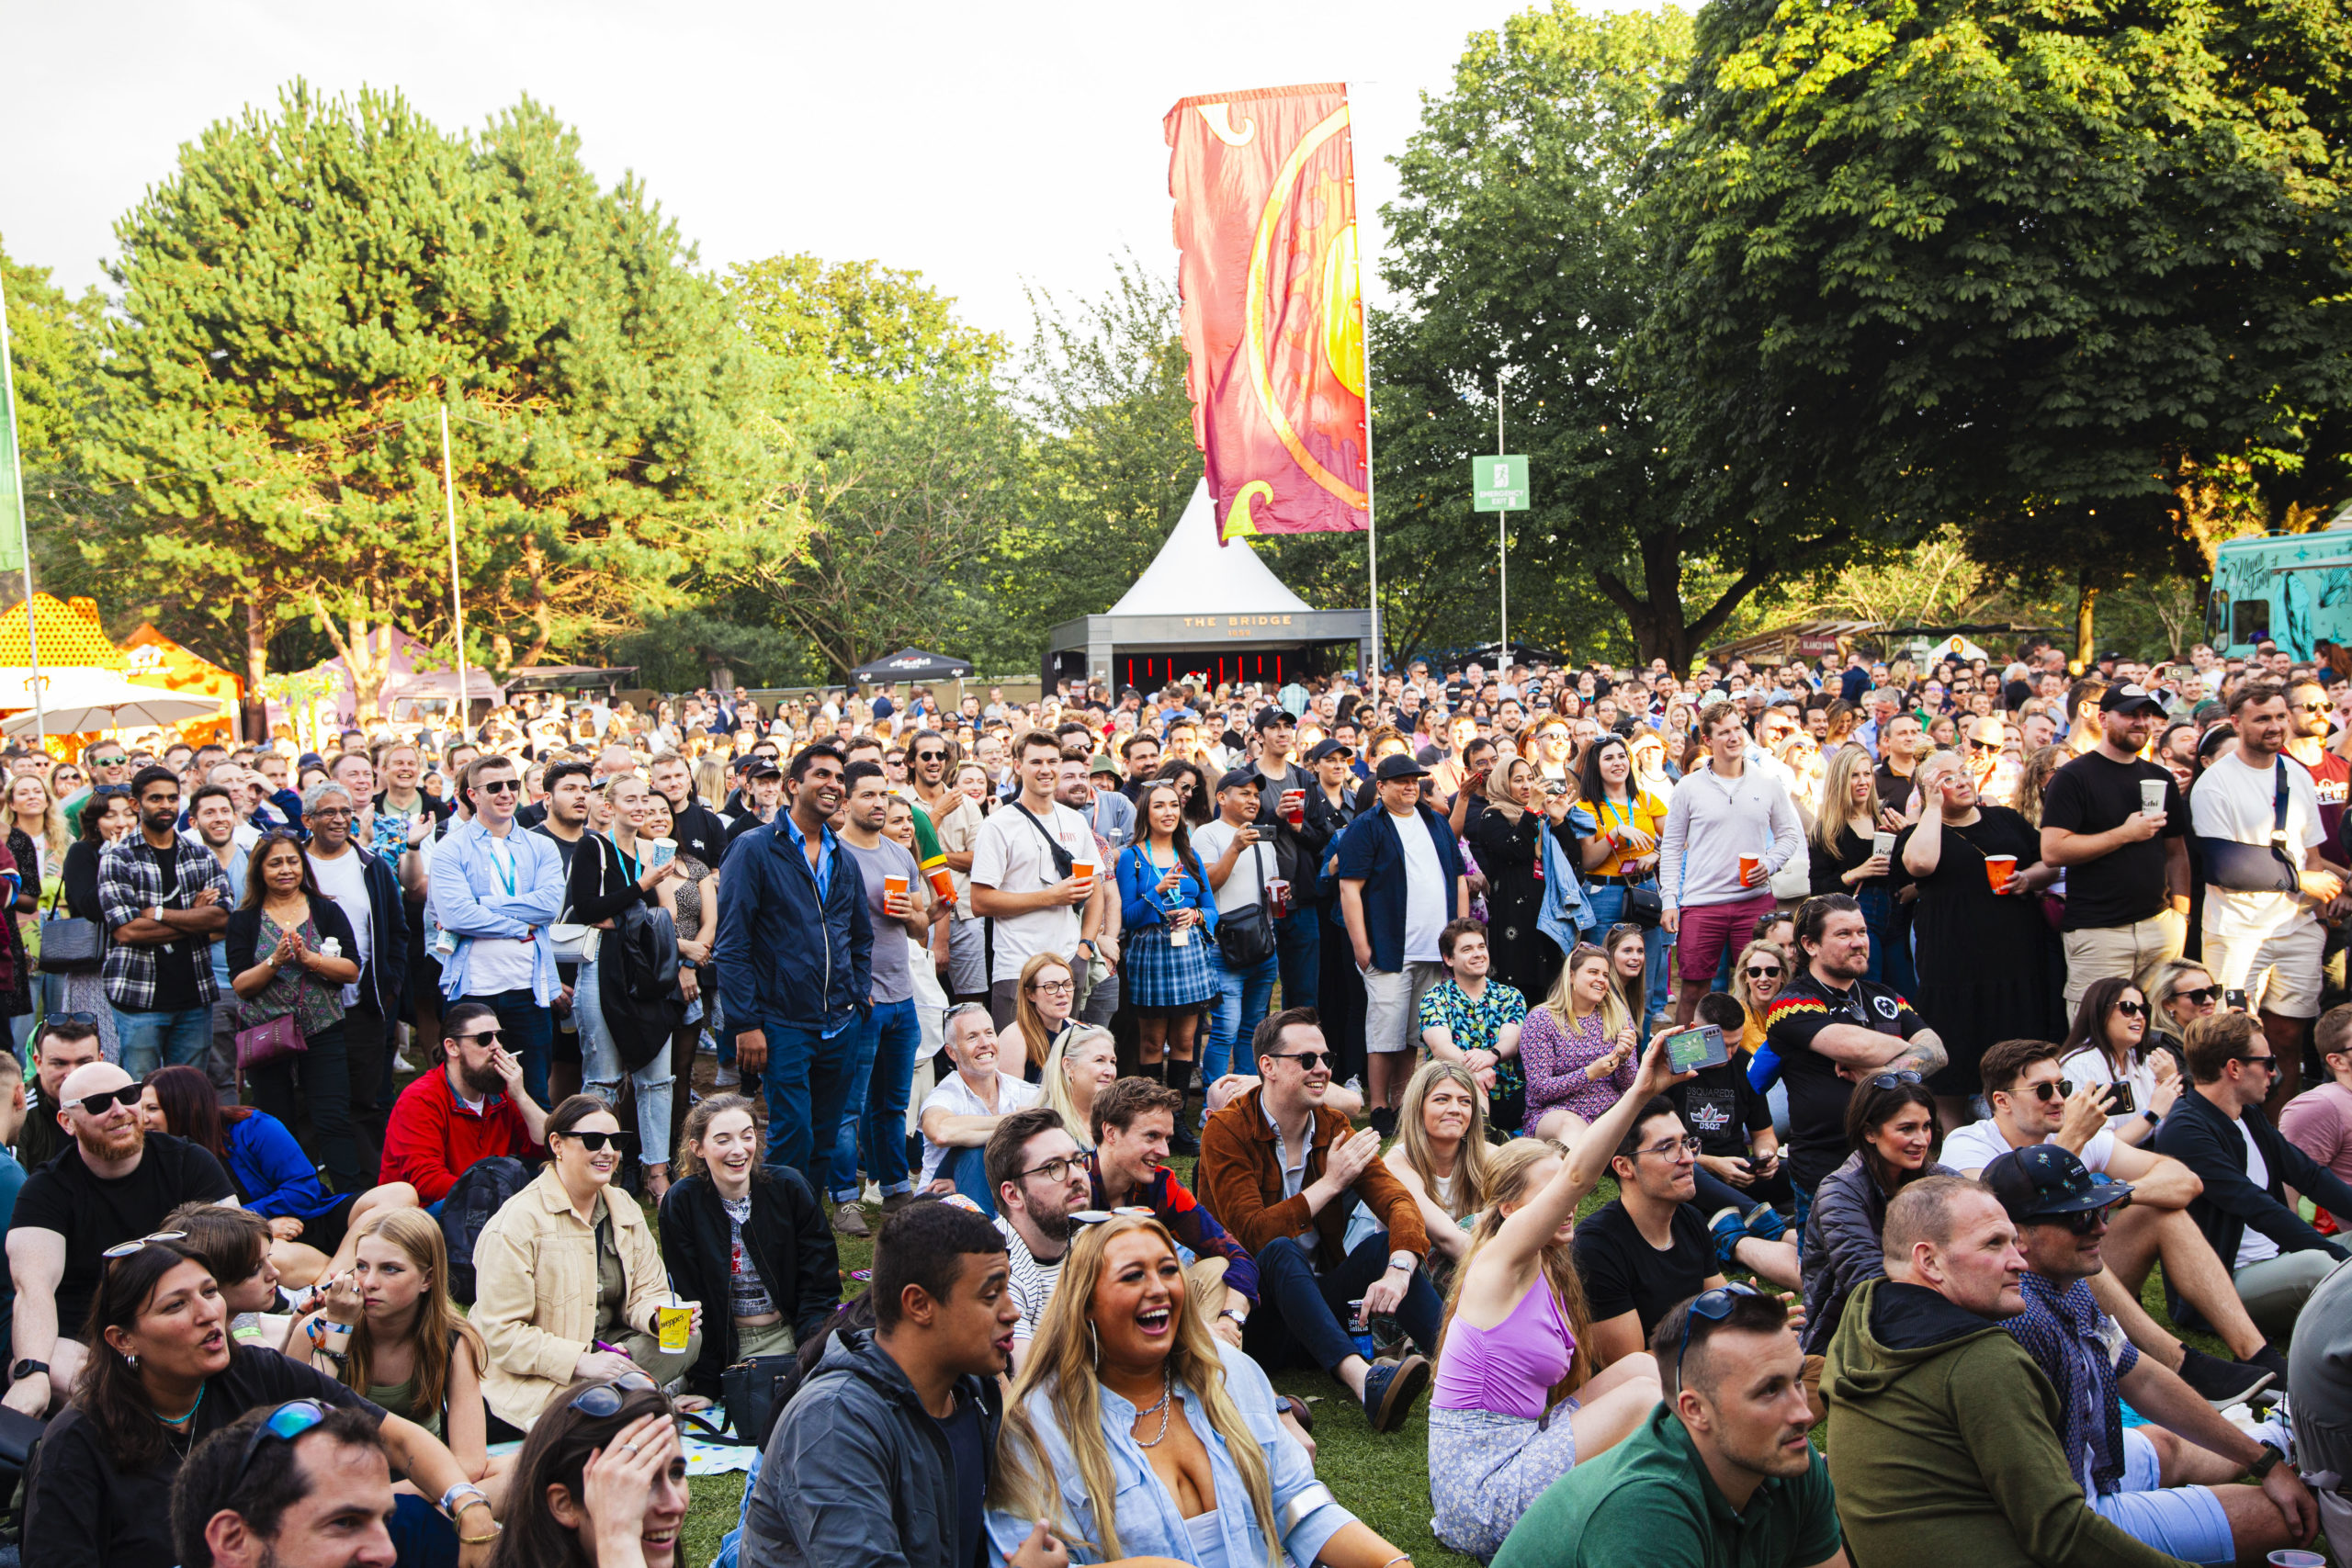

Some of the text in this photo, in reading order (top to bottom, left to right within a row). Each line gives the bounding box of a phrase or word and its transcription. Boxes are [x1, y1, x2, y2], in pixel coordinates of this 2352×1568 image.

[1183, 615, 1292, 627] THE BRIDGE
[1803, 641, 1822, 649] BLANCO
[1687, 1087, 1735, 1098] DSQUARED2
